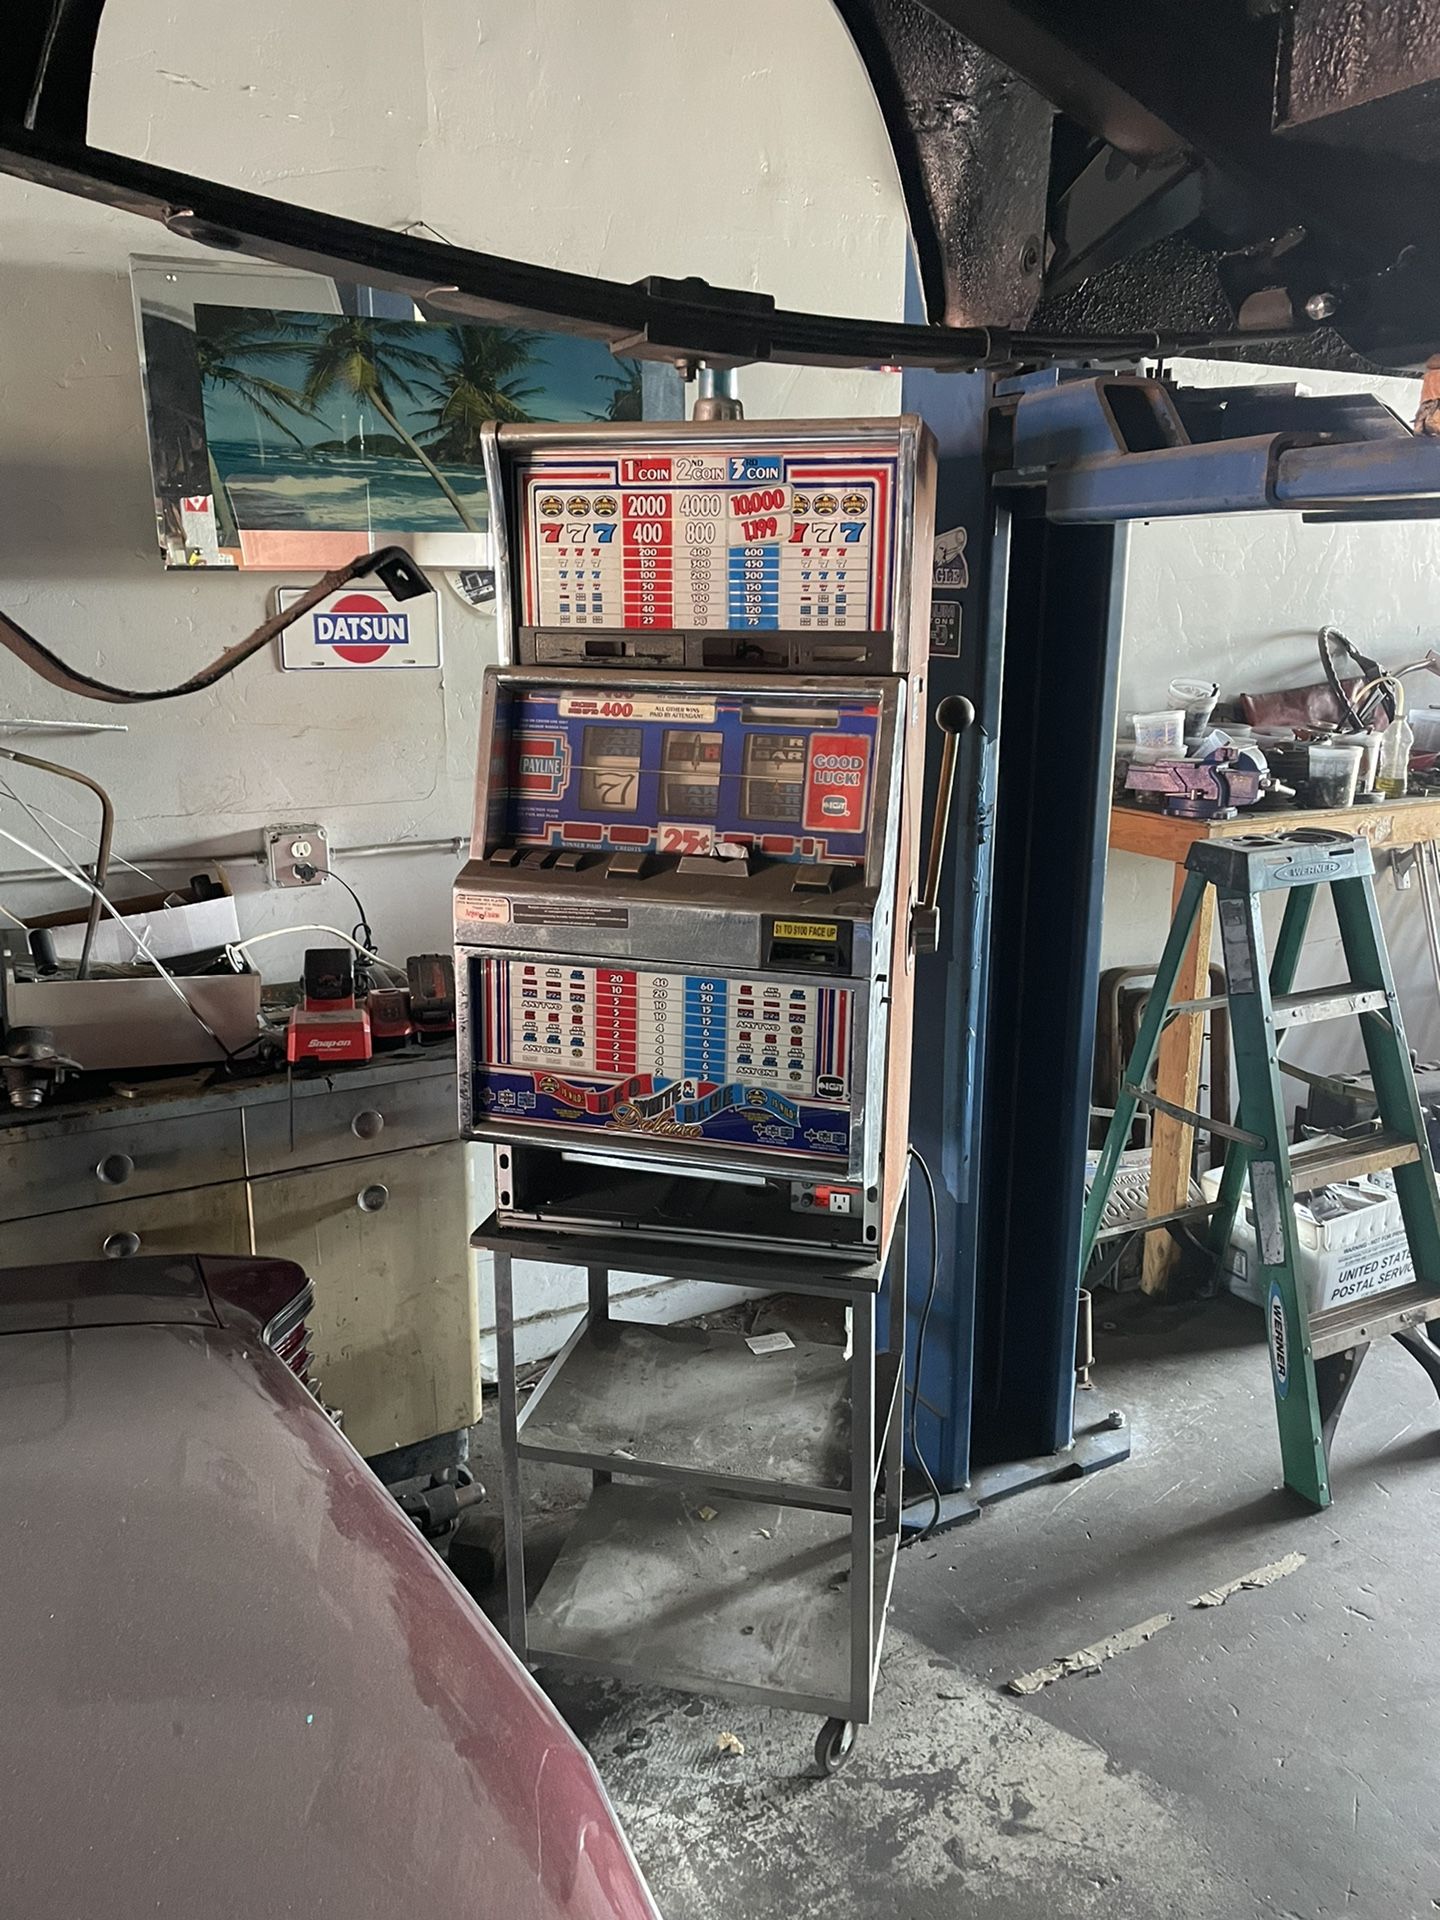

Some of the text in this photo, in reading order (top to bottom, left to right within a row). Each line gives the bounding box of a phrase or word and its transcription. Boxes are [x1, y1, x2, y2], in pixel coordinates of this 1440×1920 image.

[638, 469, 669, 480] COIN
[692, 467, 724, 480] COIN
[746, 468, 778, 480] COIN
[627, 489, 785, 517] 2000 4000 10,000
[540, 523, 564, 543] 7
[566, 523, 591, 543] 7
[593, 523, 617, 543] 7
[633, 522, 663, 544] 400
[685, 521, 716, 544] 800
[812, 522, 838, 543] 7
[840, 522, 867, 543] 7
[638, 549, 657, 557] 200
[689, 547, 711, 558] 400
[744, 548, 764, 557] 600
[640, 560, 656, 568] 150
[690, 559, 711, 569] 300
[745, 560, 763, 568] 450
[639, 571, 656, 579] 100
[690, 570, 711, 580] 200
[744, 571, 764, 580] 300
[642, 582, 655, 591] 50
[745, 583, 762, 591] 150
[642, 594, 655, 602] 50
[745, 594, 762, 603] 150
[642, 605, 655, 613] 40
[745, 605, 762, 614] 120
[317, 617, 405, 640] DATSUN
[642, 616, 654, 625] 25
[747, 617, 759, 625] 75
[600, 702, 633, 717] 400
[523, 759, 560, 774] PAYLINE
[813, 754, 864, 770] GOOD
[814, 771, 861, 787] LUCK!
[595, 772, 635, 805] 7
[664, 828, 710, 856] 25¢
[1290, 864, 1335, 877] WERNER
[775, 923, 836, 938] $1 TO $100 FACE UP
[610, 975, 623, 983] 20
[652, 977, 668, 988] 40
[700, 982, 714, 991] 60
[611, 986, 713, 1003] 10 20 30
[654, 1001, 667, 1011] 10
[702, 1005, 712, 1014] 15
[521, 1000, 540, 1008] ANY
[540, 1001, 562, 1010] TWO
[654, 1012, 667, 1022] 10
[702, 1017, 711, 1026] 15
[736, 1021, 758, 1029] ANY
[757, 1022, 781, 1032] TWO
[613, 1020, 710, 1037] 2 4 6
[307, 1039, 352, 1048] Snap-on
[613, 1031, 620, 1039] 2
[655, 1034, 664, 1044] 4
[703, 1040, 710, 1048] 6
[613, 1042, 709, 1059] 2 4 6
[522, 1044, 778, 1077] ANY ONE 2 4 6 ANY ONE
[614, 1064, 619, 1072] 1
[655, 1068, 664, 1077] 2
[600, 1079, 640, 1111] RED
[633, 1080, 695, 1118] WHITE &
[685, 1087, 734, 1122] BLUE
[605, 1102, 704, 1137] Deluxe
[1338, 1260, 1379, 1283] UNITED
[1381, 1249, 1411, 1269] STATE
[1331, 1262, 1413, 1301] POSTAL SERVIC
[1273, 1304, 1286, 1377] WERNER
